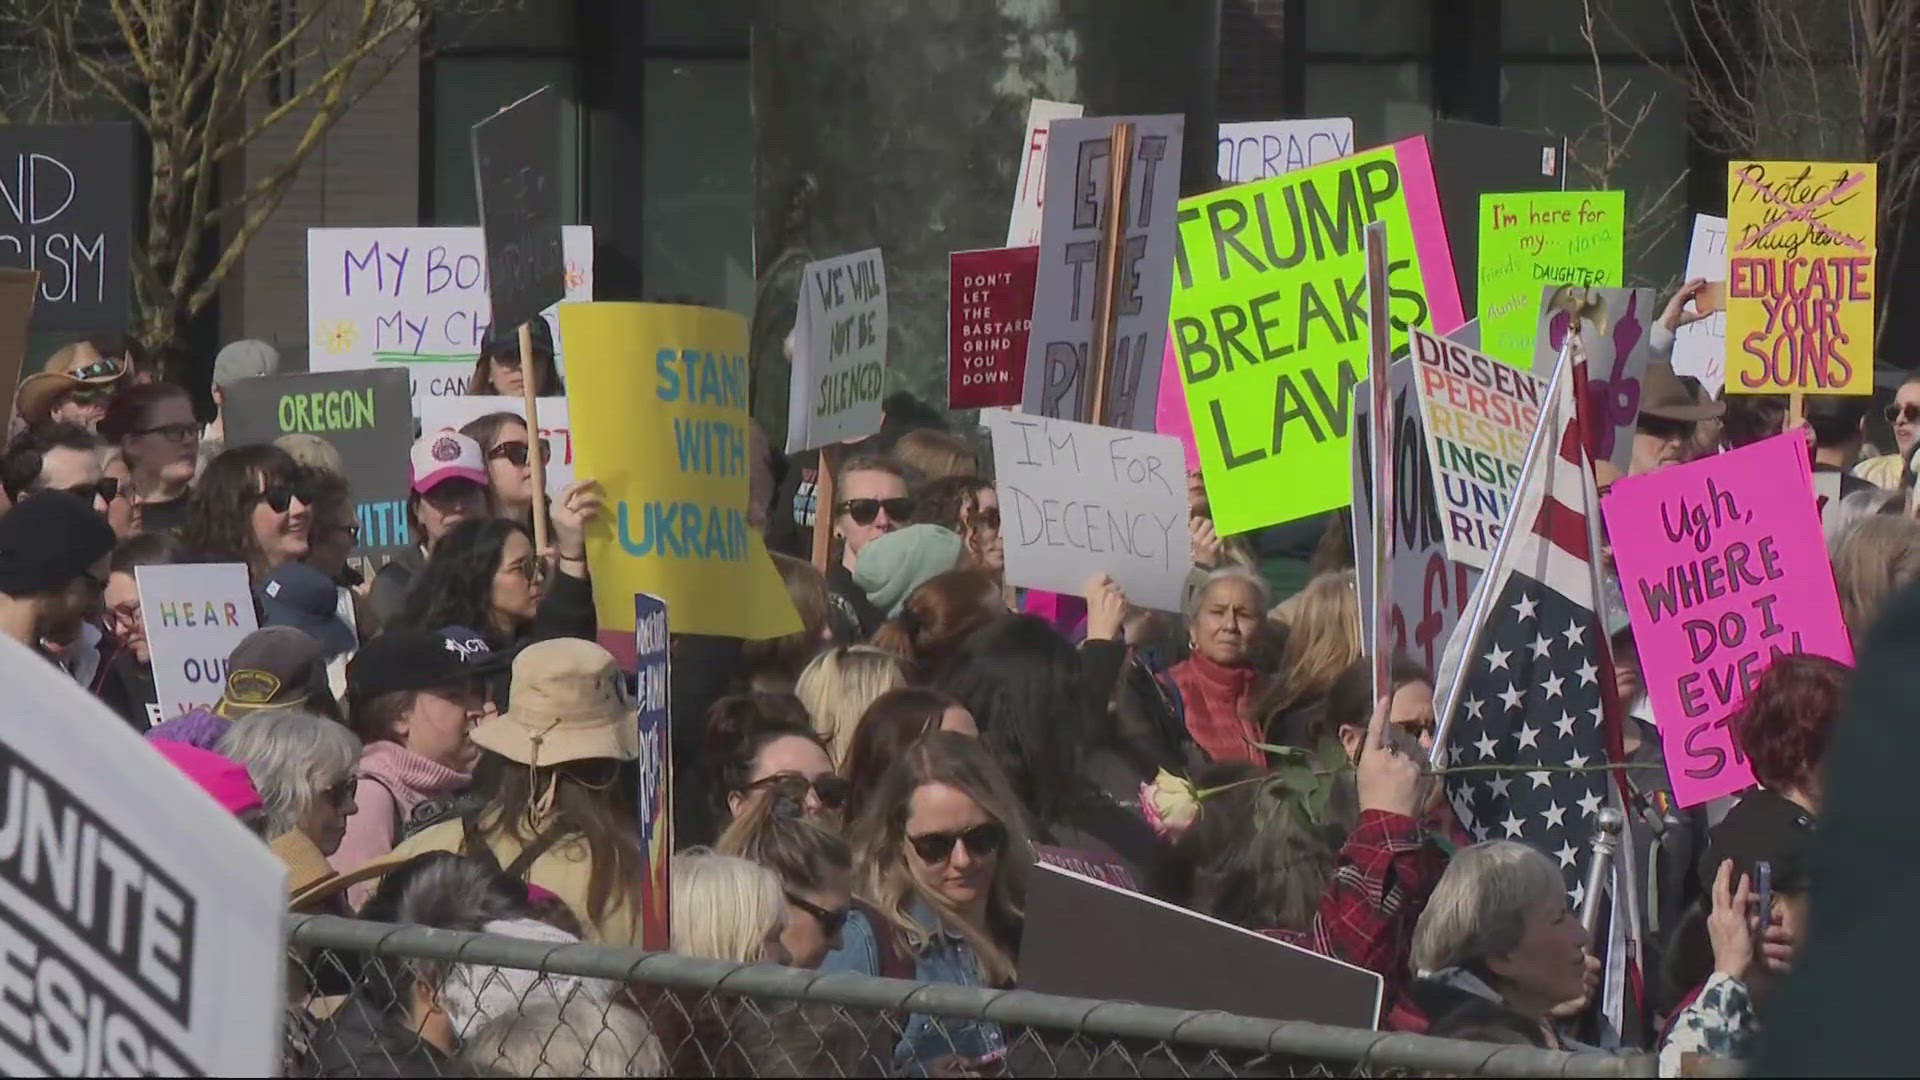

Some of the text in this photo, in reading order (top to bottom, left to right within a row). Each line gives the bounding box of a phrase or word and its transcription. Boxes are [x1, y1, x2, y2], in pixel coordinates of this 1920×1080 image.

[1073, 135, 1168, 231] ET
[1731, 163, 1862, 206] Protect
[1174, 158, 1400, 290] TRUMP
[1492, 198, 1606, 231] I'm here for
[343, 241, 490, 297] MY BO
[816, 258, 881, 313] WE WILL
[963, 272, 1013, 288] DON'T
[963, 290, 990, 304] LET
[1064, 234, 1148, 322] TE
[1729, 256, 1872, 301] EDUCATE
[375, 309, 429, 356] MY
[829, 310, 877, 364] NOT BE
[963, 307, 992, 320] THE
[1173, 258, 1429, 385] BREAKS
[1761, 299, 1841, 335] YOUR
[963, 337, 1012, 353] GRIND
[963, 355, 996, 368] YOU
[1414, 330, 1548, 408] DISSEN
[1740, 331, 1853, 389] SONS
[655, 346, 748, 411] STAND
[816, 359, 884, 419] SILENCED
[1041, 332, 1148, 430] RIH
[278, 387, 375, 433] OREGON
[673, 416, 746, 478] WITH
[1008, 419, 1174, 496] I'M FOR
[1007, 484, 1179, 573] DECENCY
[1660, 476, 1754, 552] Ugh,
[1638, 535, 1785, 625] WHERE
[160, 600, 240, 628] HEAR
[1682, 594, 1785, 664] DO I
[0, 914, 198, 1078] ESIS
